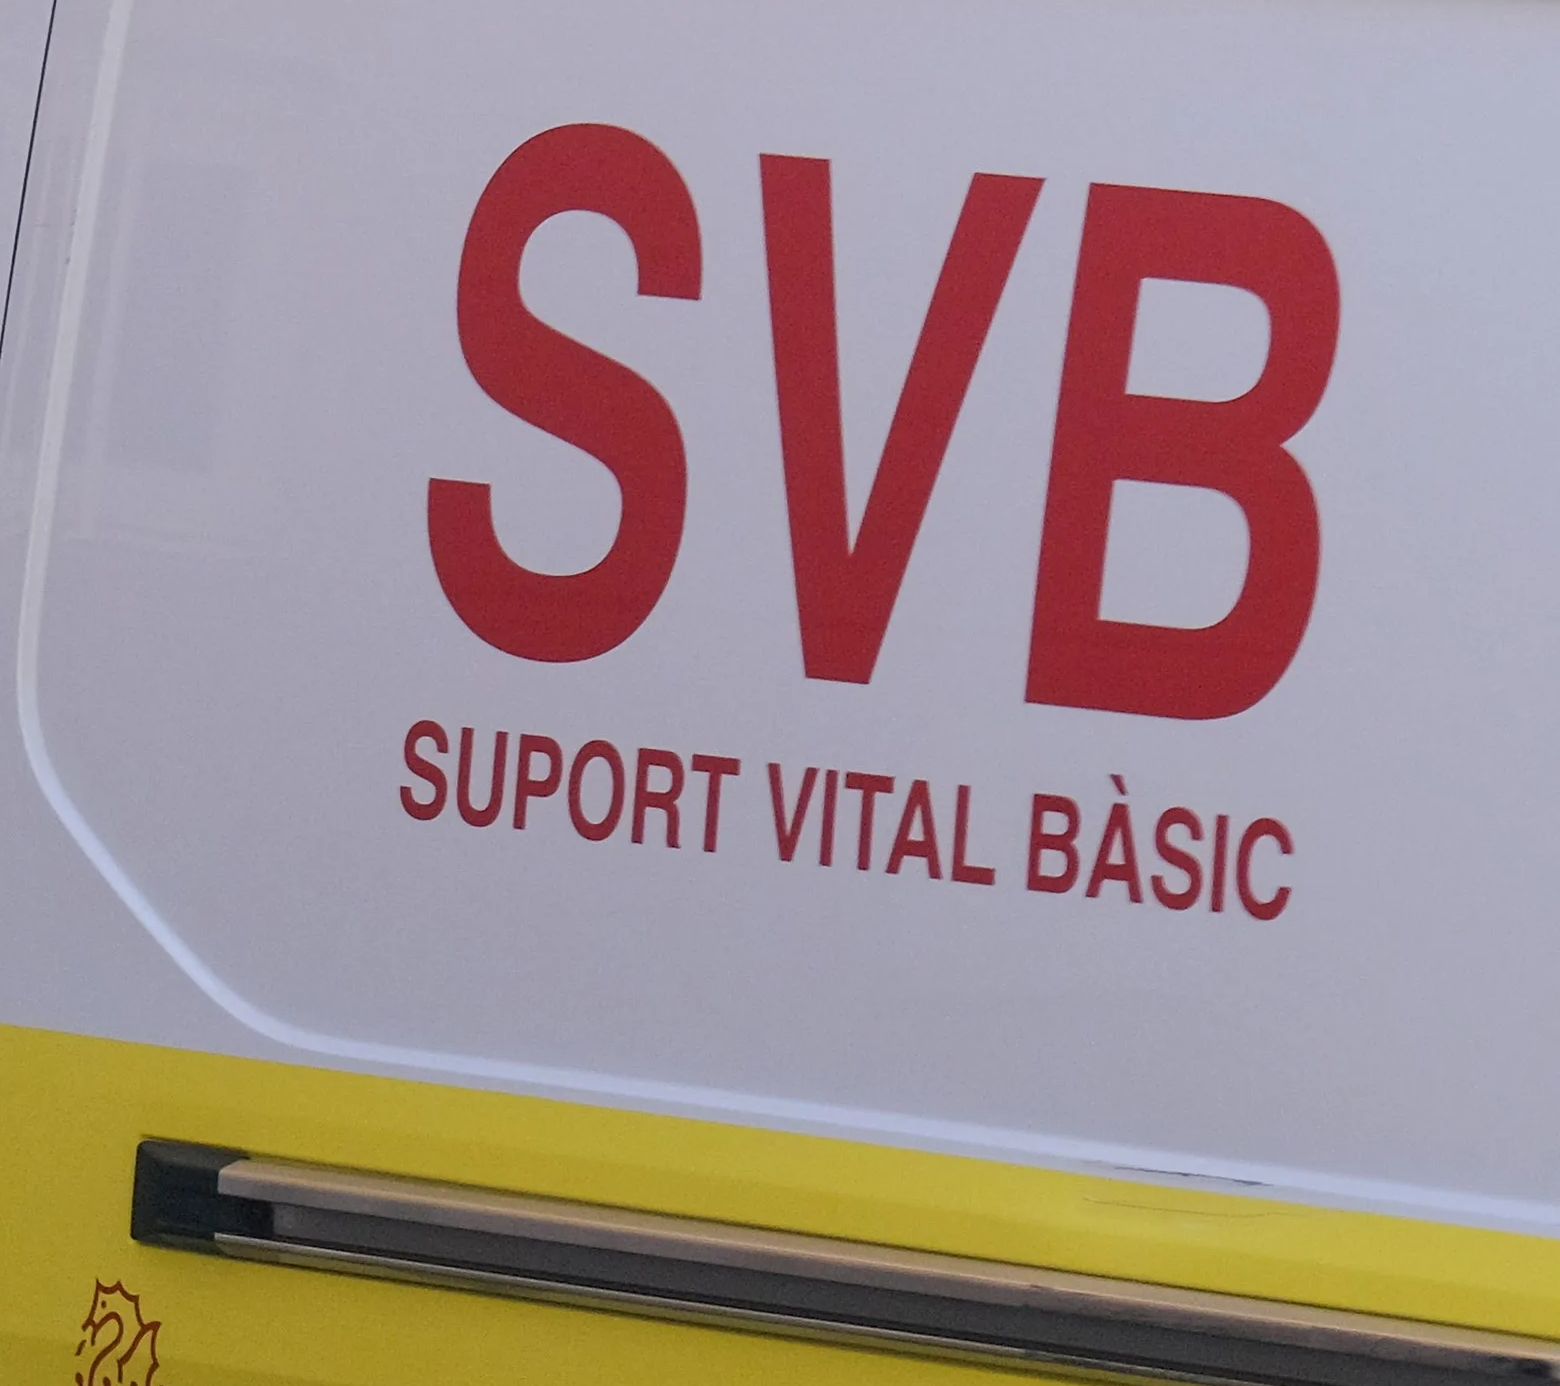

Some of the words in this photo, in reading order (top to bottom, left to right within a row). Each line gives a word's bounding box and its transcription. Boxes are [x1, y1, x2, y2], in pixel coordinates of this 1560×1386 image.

[427, 121, 1341, 722] SVB
[398, 718, 741, 853] SUPORT
[766, 761, 996, 886] VITAL
[1026, 774, 1295, 922] BÀSIC
